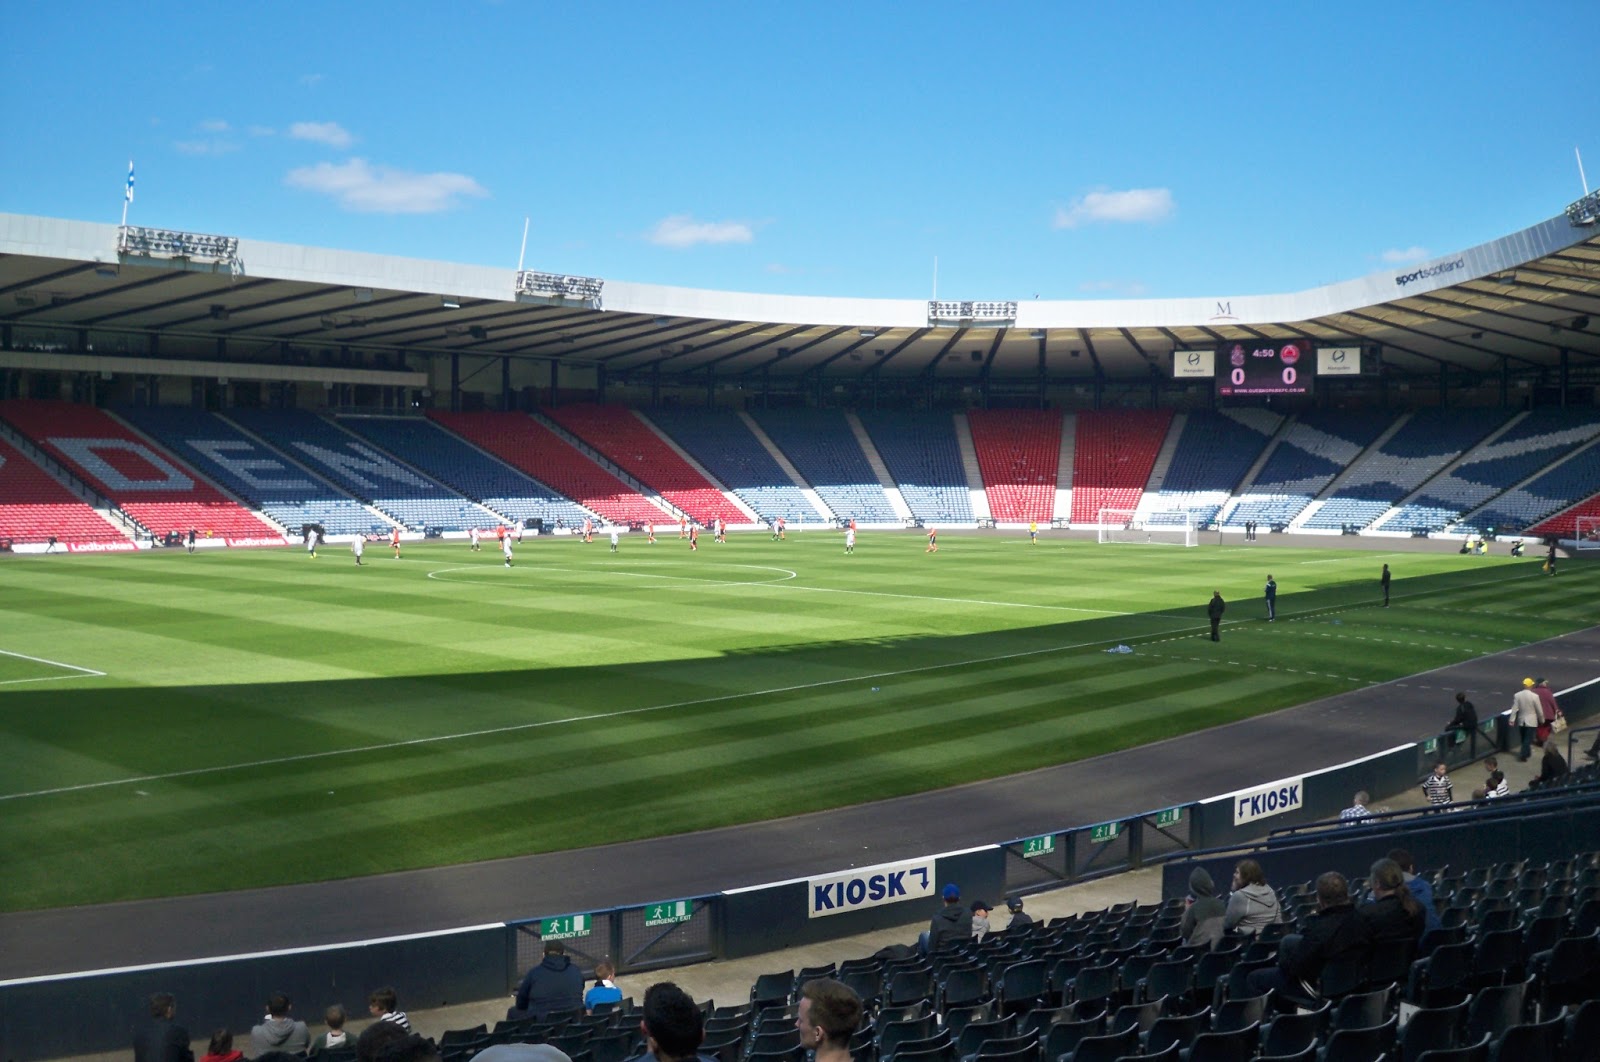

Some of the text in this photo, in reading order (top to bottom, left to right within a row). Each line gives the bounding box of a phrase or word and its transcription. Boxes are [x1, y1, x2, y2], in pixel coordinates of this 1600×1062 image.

[1396, 257, 1465, 286] sportscotland
[1216, 302, 1232, 316] M
[1252, 349, 1275, 358] 4:50
[1231, 367, 1297, 386] 0 0
[0, 437, 434, 491] DEN
[71, 541, 135, 552] Ladbrokes
[231, 536, 286, 547] Ladbrokes
[1251, 784, 1299, 816] KIOSK
[815, 870, 907, 912] KIOSK
[645, 917, 678, 927] EMERGENCY
[541, 931, 576, 942] EMERGENCY
